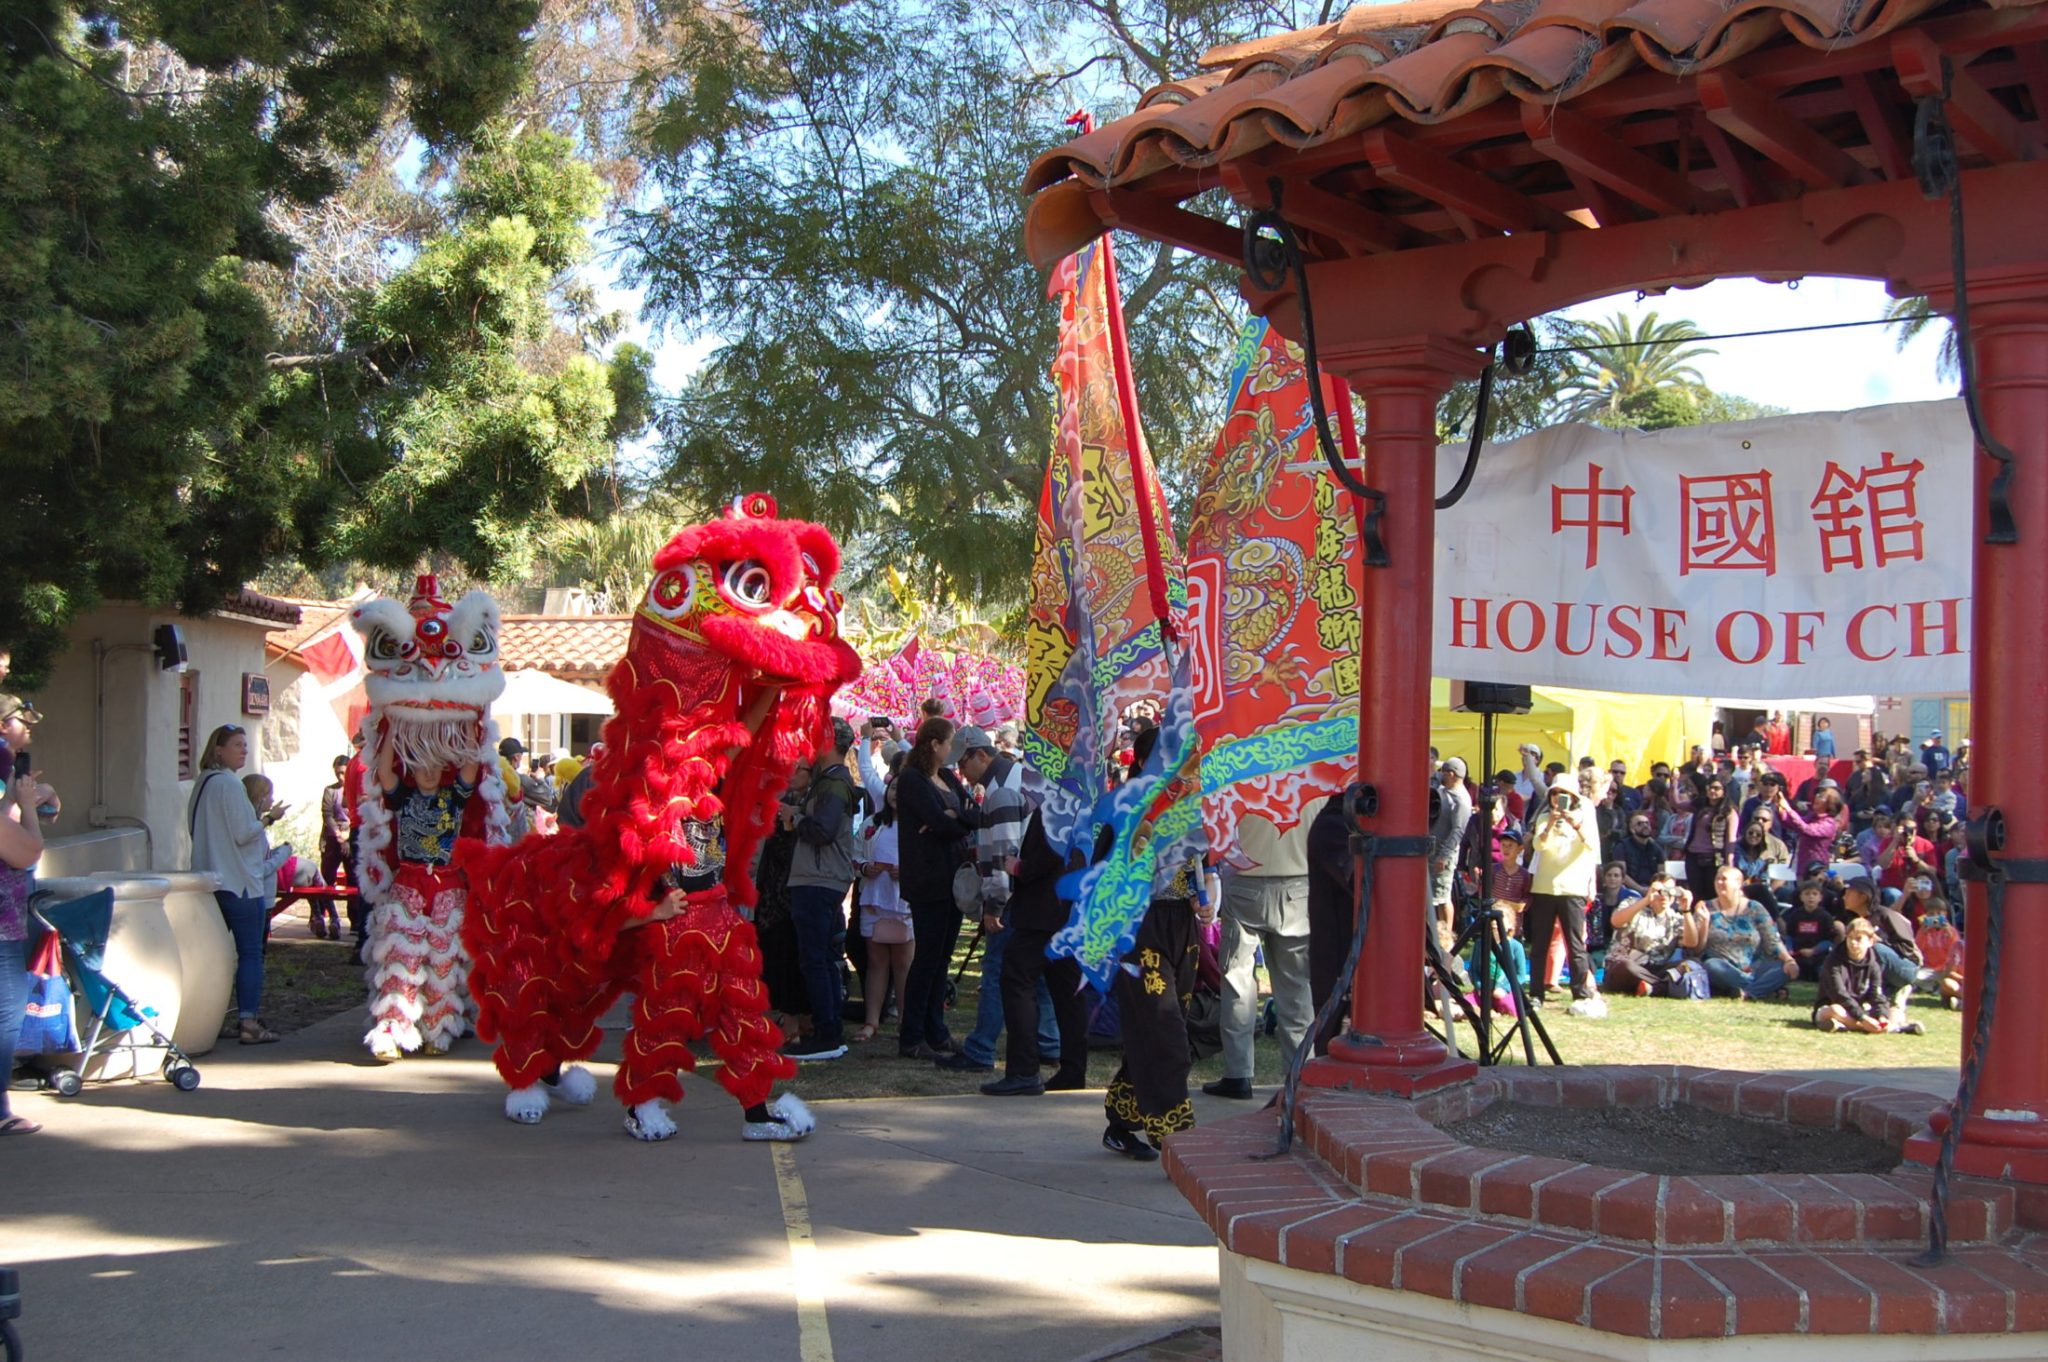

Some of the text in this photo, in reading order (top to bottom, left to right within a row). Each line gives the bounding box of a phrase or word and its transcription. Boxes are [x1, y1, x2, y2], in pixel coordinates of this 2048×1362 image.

[1448, 595, 1972, 665] HOUSE OF CH
[1140, 947, 1167, 995] 南海
